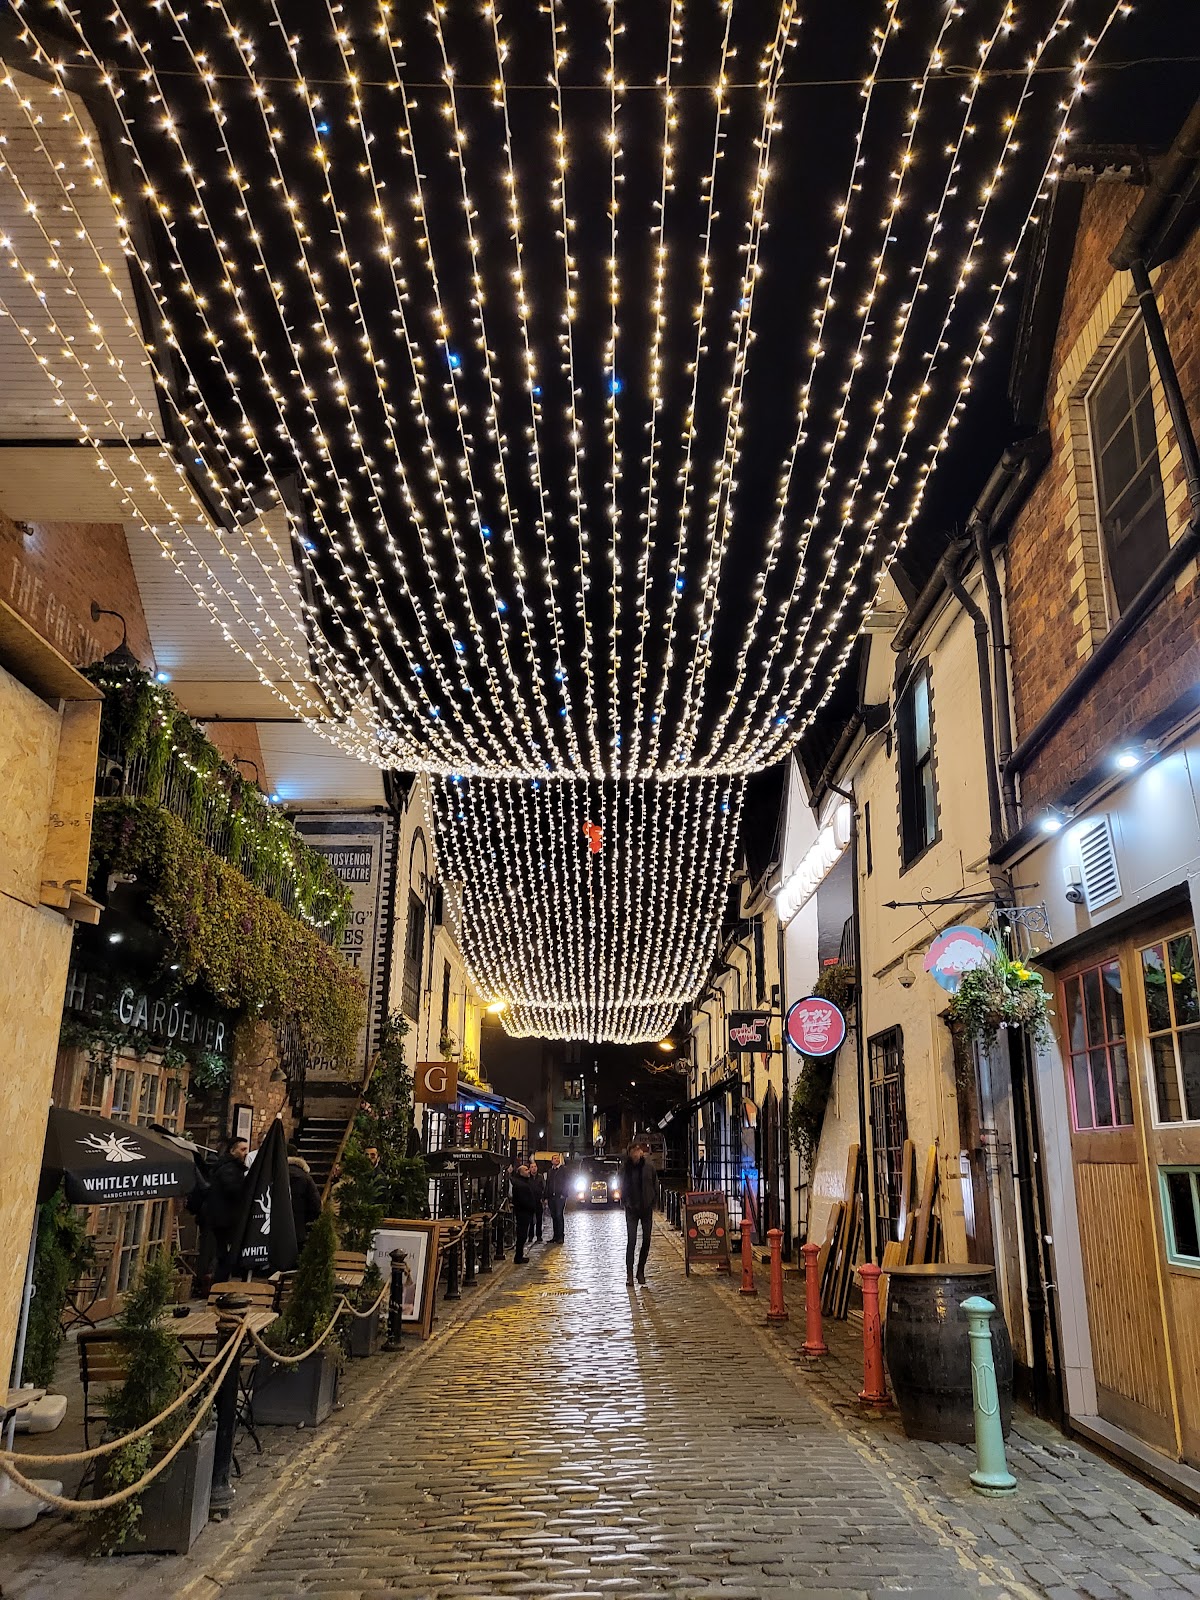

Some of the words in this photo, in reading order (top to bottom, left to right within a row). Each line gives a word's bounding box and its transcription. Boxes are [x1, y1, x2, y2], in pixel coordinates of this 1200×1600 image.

[10, 556, 43, 620] THE
[337, 867, 370, 880] THEATRE
[119, 987, 225, 1052] GARDENER
[424, 1066, 449, 1093] G
[83, 1174, 139, 1191] WHITLEY
[142, 1172, 179, 1187] NEILL
[103, 1190, 144, 1199] HANDCRAFTED
